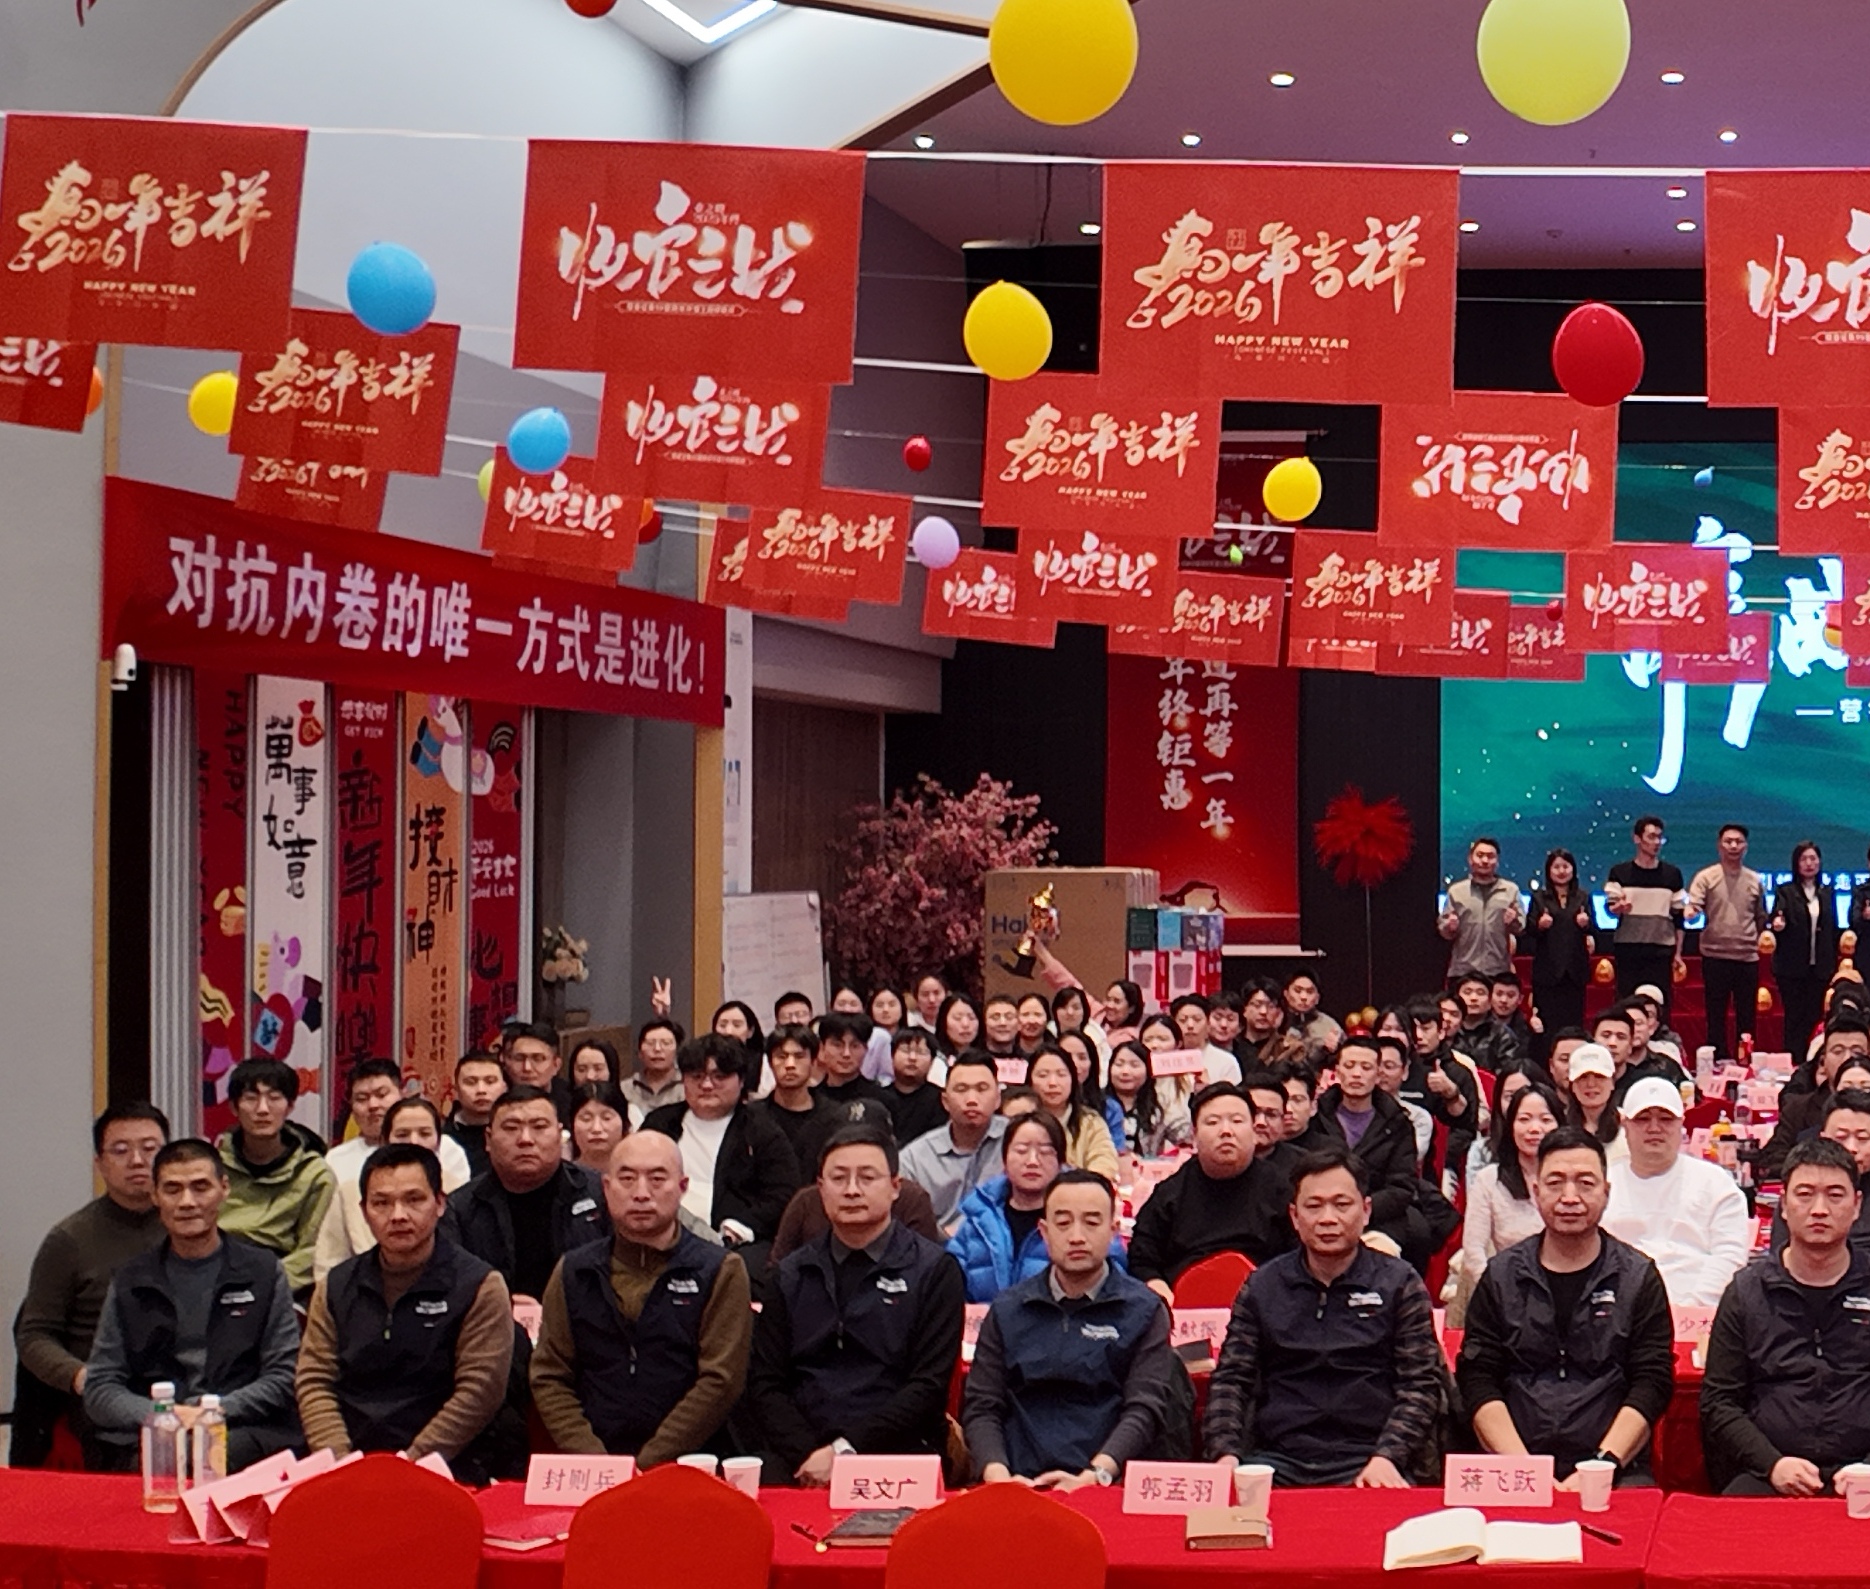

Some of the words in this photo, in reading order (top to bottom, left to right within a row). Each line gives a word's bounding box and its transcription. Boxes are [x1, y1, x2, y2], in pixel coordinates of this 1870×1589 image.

[1214, 334, 1265, 345] HAPPY
[1271, 336, 1304, 347] NEW
[1310, 337, 1350, 349] YEAR
[849, 1477, 920, 1503] 吴文广
